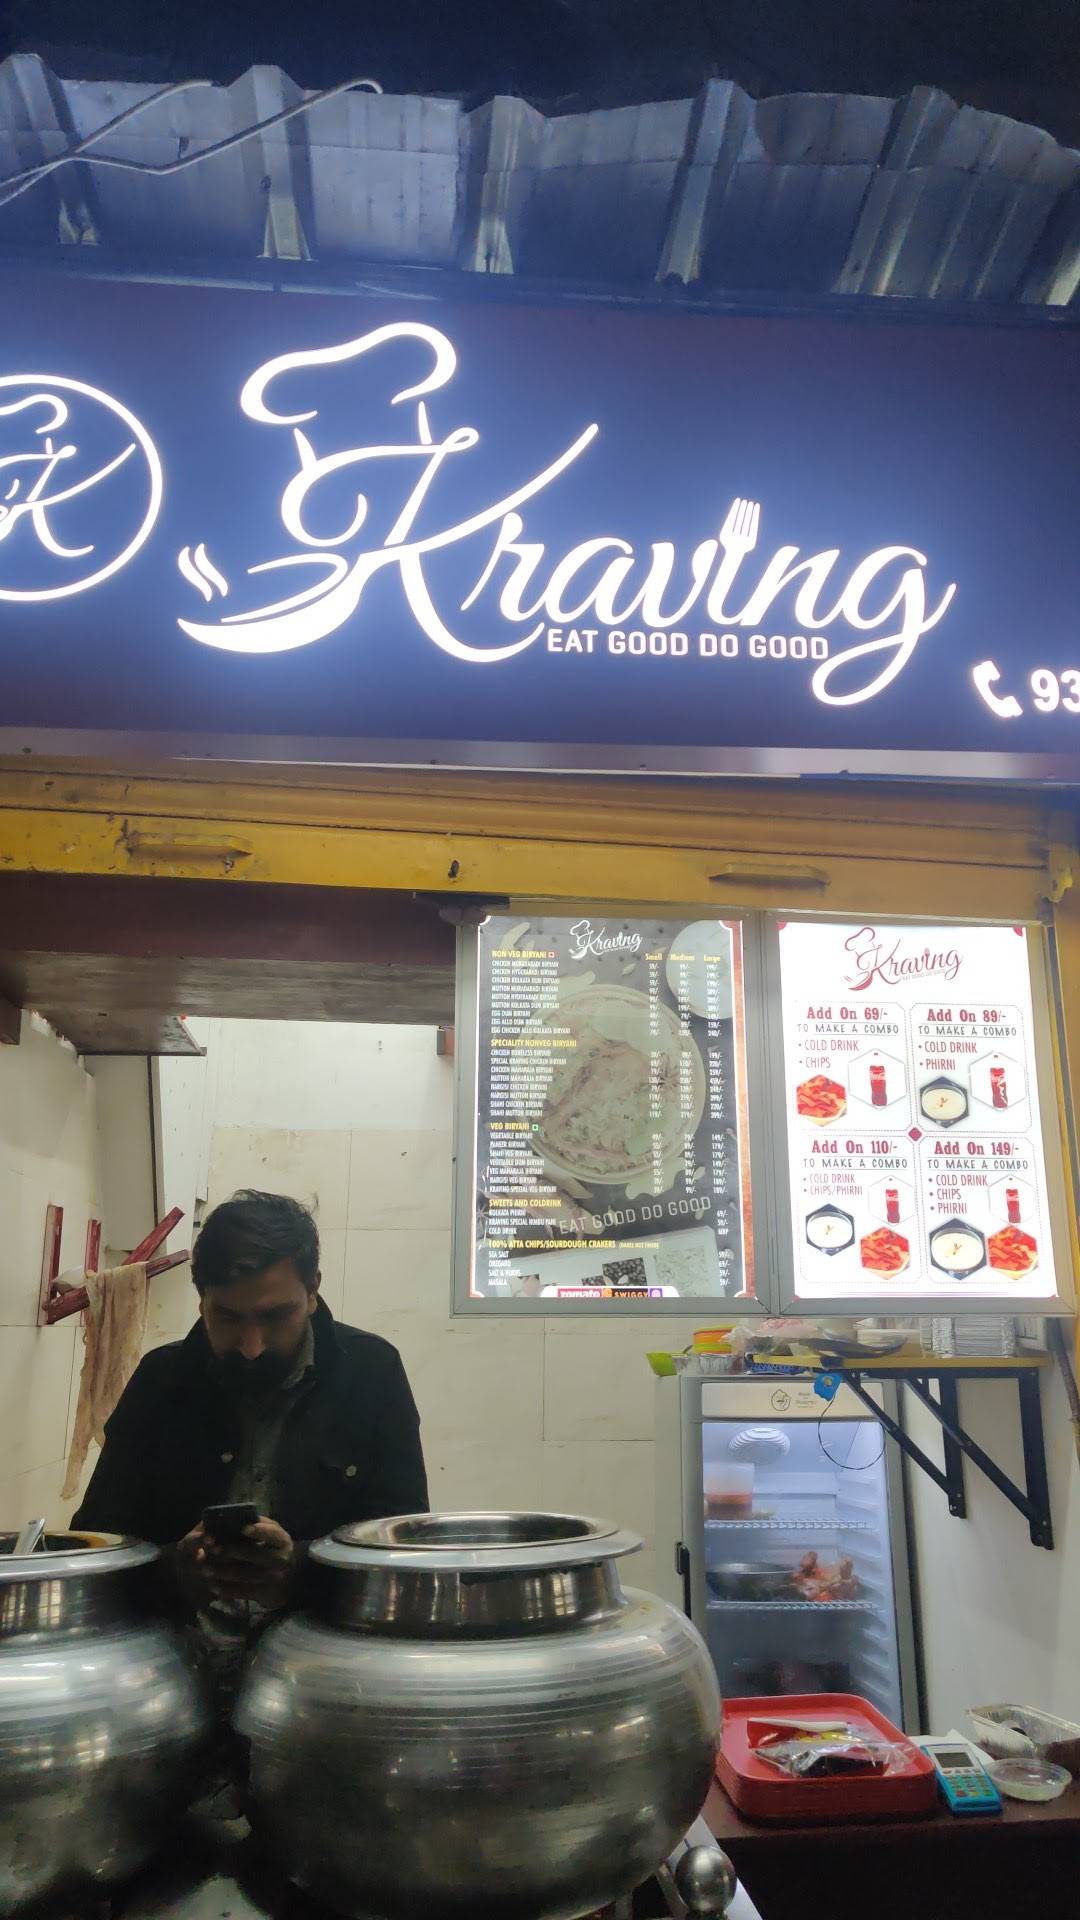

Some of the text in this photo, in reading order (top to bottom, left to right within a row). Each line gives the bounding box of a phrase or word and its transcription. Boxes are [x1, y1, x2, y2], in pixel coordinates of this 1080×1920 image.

[283, 422, 957, 707] Kraving
[548, 628, 830, 661] EAT GOOD DO GOOD
[578, 926, 643, 956] Kraving
[492, 950, 547, 958] NON VEG BIRYANI
[860, 939, 964, 985] Kraving
[807, 1007, 888, 1020] Add On 69/-
[927, 1009, 1006, 1022] Add On 89/-
[797, 1024, 899, 1034] TO MAKE A COMBO
[918, 1026, 1017, 1036] TO MAKE A COMBO
[490, 1039, 577, 1047] SPECIALITY NONVEG BIRYANI
[804, 1040, 859, 1051] COLD DRINK
[924, 1042, 977, 1053] COLD DRINK
[805, 1056, 831, 1068] CHIPS
[926, 1059, 956, 1070] PHIRNI
[490, 1122, 529, 1130] VEG BIRYANI
[812, 1141, 898, 1154] Add On 110/-
[935, 1142, 1019, 1155] Add On 149/-
[804, 1159, 908, 1168] TO MAKE A COMBO
[928, 1160, 1028, 1169] TO MAKE A COMBO
[810, 1173, 855, 1184] COLD DRINK
[936, 1175, 987, 1186] COLD DRINK
[810, 1186, 863, 1195] CHIPS/PHIRNI
[937, 1189, 961, 1200] CHIPS
[488, 1199, 561, 1208] SWEETS AND COLDRINK
[938, 1203, 967, 1214] PHIRNI
[559, 1196, 712, 1235] EAT GOOD DO GOOD
[488, 1239, 508, 1248] 100%
[508, 1239, 523, 1248] ATTA
[524, 1239, 585, 1248] CHIPS/SOURDOUGH
[587, 1239, 614, 1248] CRAKERS
[488, 1249, 509, 1258] SEA SALT
